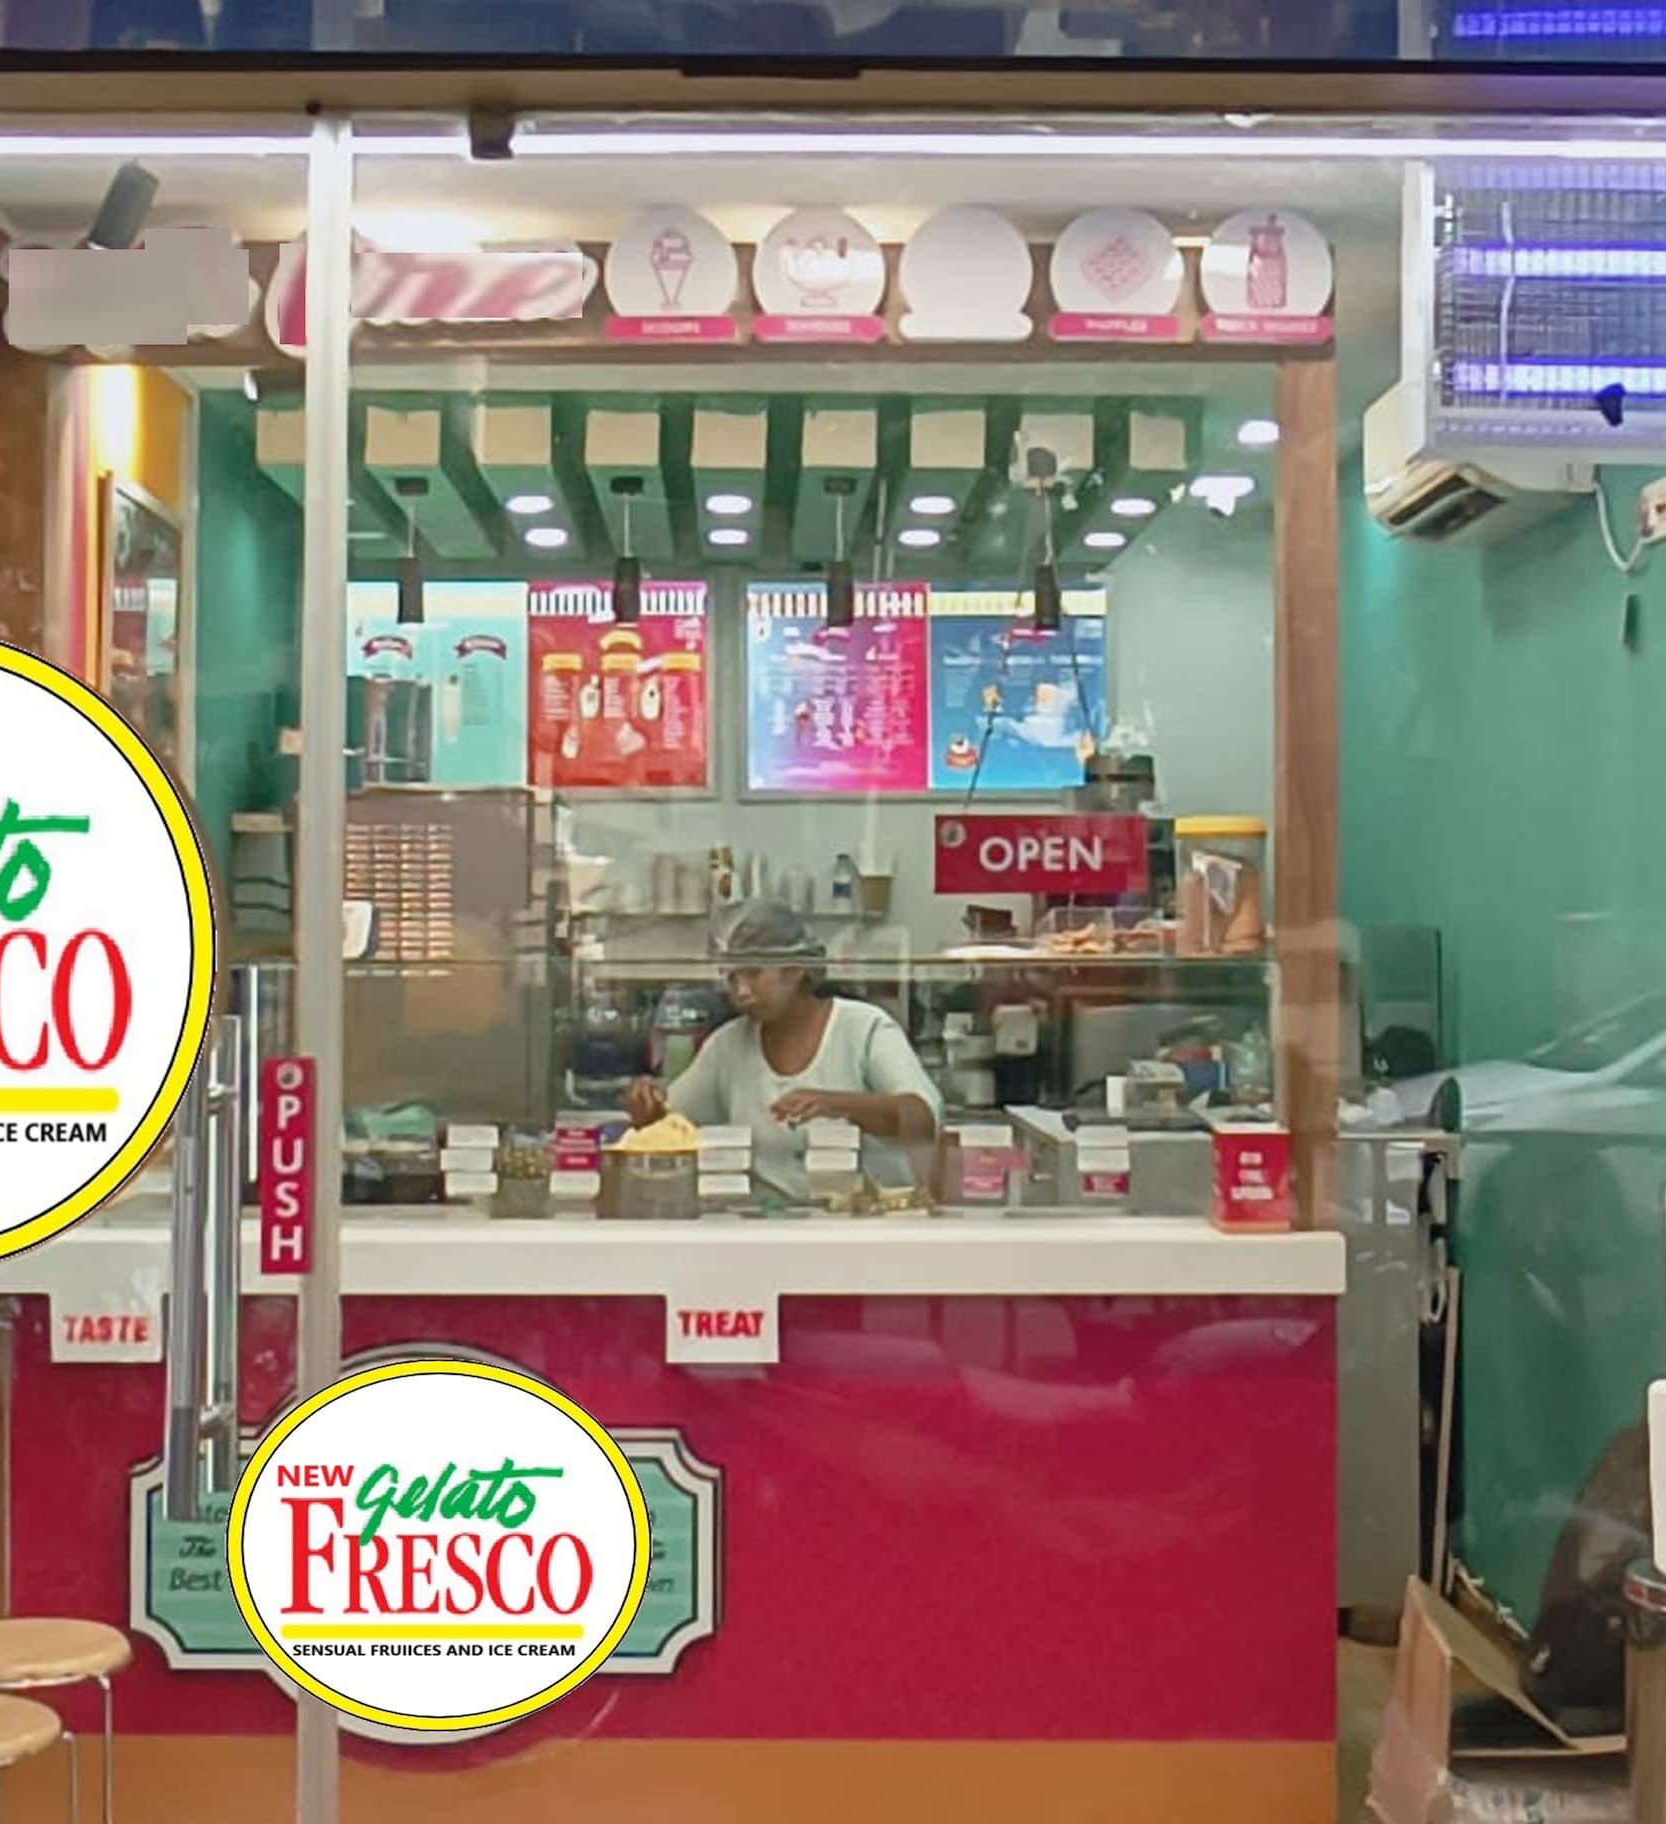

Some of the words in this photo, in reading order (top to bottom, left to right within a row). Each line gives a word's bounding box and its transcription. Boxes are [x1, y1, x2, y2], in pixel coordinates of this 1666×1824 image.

[978, 835, 1104, 873] OPEN
[270, 1093, 304, 1262] PUSH
[64, 1314, 149, 1343] TASTE
[678, 1310, 764, 1338] TREAT
